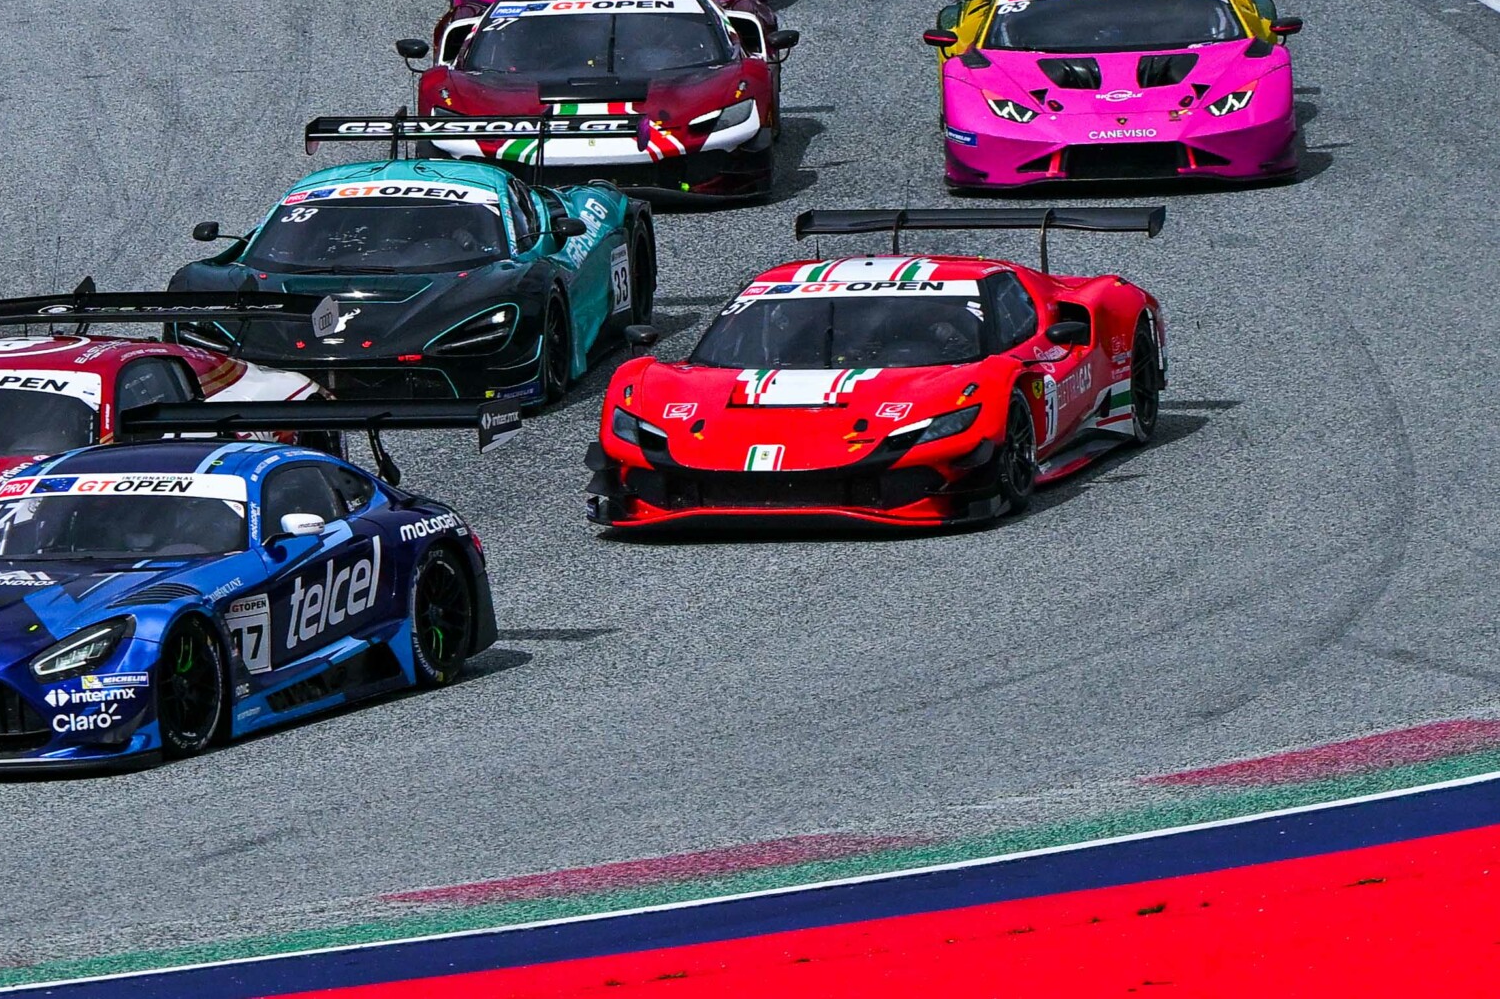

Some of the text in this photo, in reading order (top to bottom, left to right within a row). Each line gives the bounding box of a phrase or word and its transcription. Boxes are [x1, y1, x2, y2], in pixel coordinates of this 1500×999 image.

[997, 1, 1029, 16] 63
[483, 18, 518, 32] 27
[578, 119, 629, 132] GT
[1089, 128, 1157, 139] CANEVISIO
[287, 194, 306, 203] PRO
[281, 207, 318, 223] 33
[613, 267, 629, 307] 33
[745, 286, 765, 295] PRO
[722, 299, 753, 317] 51
[1, 481, 28, 495] PRO
[287, 535, 382, 650] telcel
[102, 675, 147, 684] MICHELIN
[71, 688, 136, 704] inter.mx
[52, 706, 117, 733] Claro
